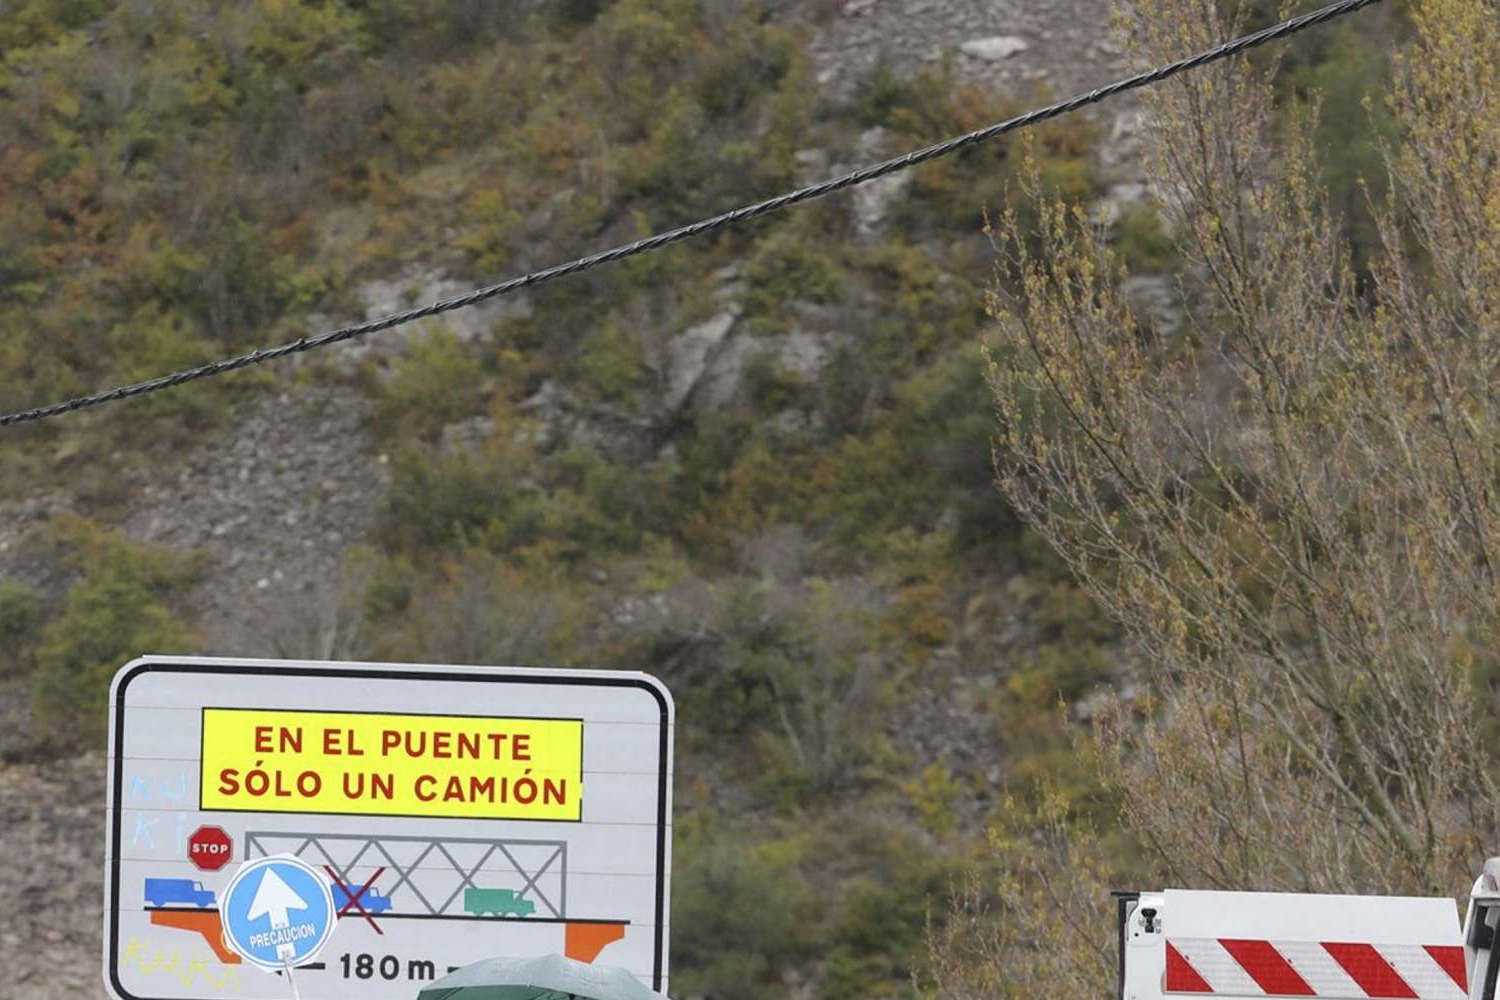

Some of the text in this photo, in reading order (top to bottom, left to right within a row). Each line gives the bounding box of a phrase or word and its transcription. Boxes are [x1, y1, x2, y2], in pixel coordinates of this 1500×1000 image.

[255, 726, 531, 761] EN EL PUENTE
[218, 760, 566, 805] SÓLO UN CAMIÓN
[192, 843, 228, 855] STOP
[249, 923, 316, 949] PRECAUCION
[340, 953, 435, 981] 180 m
